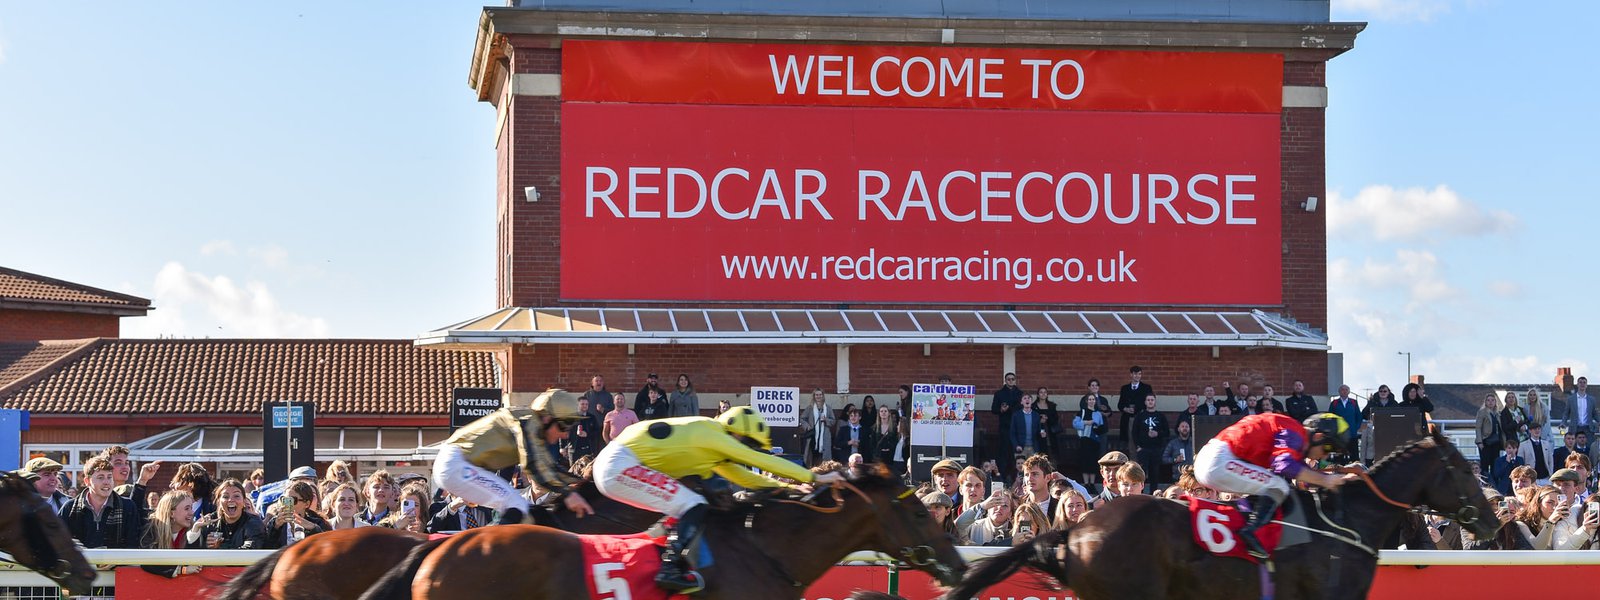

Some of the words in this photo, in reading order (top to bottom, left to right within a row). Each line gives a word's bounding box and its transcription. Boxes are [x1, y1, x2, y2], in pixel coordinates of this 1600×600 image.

[769, 55, 1004, 98] WELCOME
[1021, 59, 1085, 100] TO
[585, 167, 834, 220] REDCAR
[858, 169, 1257, 225] RACECOURSE
[721, 248, 1138, 289] www.redcarracing.co.uk
[456, 398, 499, 407] OSTLERS
[757, 390, 793, 400] DEREK
[758, 403, 793, 414] WOOD
[1196, 508, 1236, 553] 6
[592, 562, 632, 600] 5
